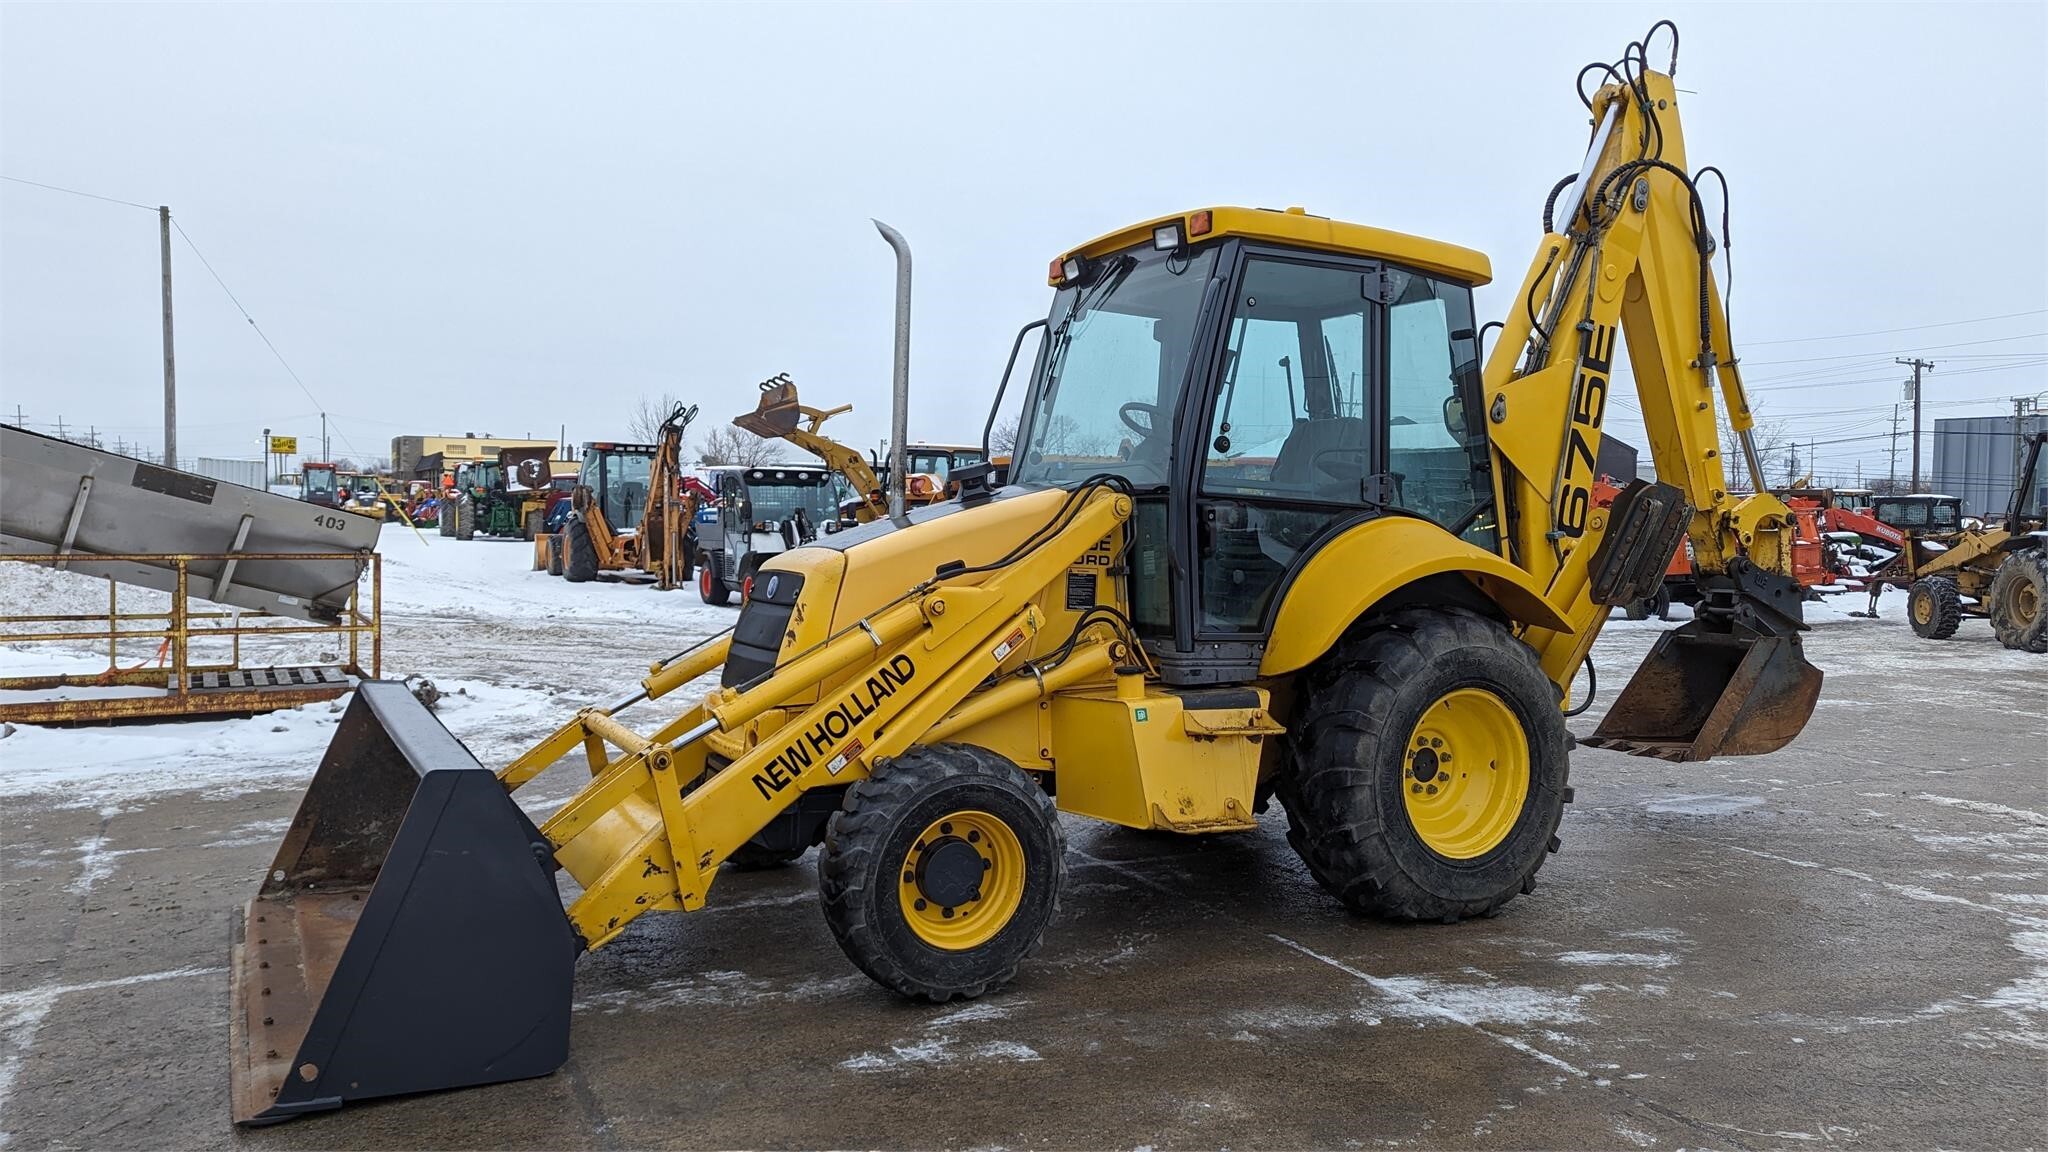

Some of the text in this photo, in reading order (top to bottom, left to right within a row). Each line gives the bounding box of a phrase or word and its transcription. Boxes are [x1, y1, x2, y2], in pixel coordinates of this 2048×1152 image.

[1558, 320, 1616, 539] 675E
[313, 514, 346, 531] 403
[1876, 525, 1902, 541] KUBOTA
[751, 653, 915, 801] NEW HOLLAND
